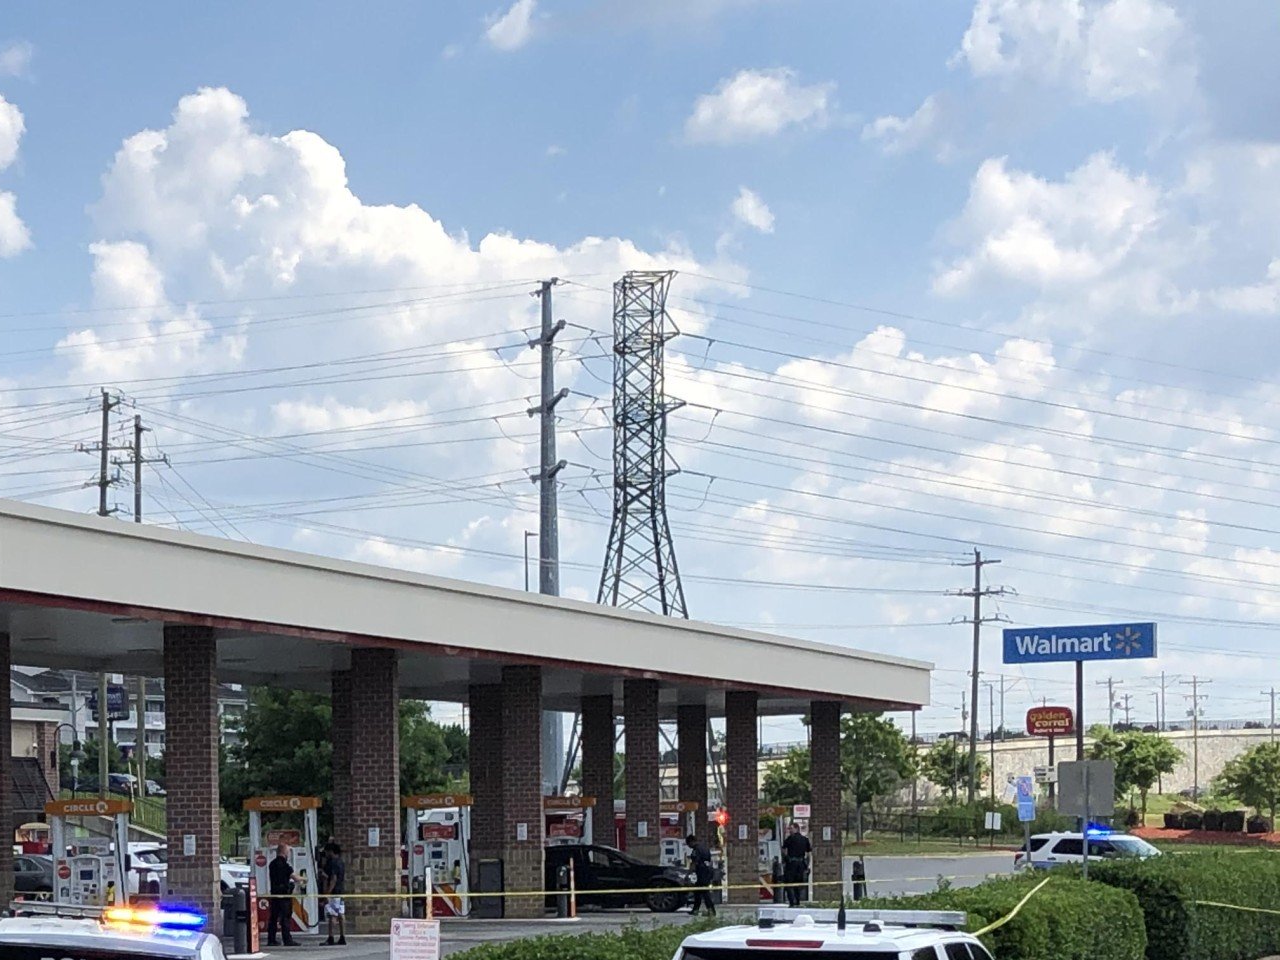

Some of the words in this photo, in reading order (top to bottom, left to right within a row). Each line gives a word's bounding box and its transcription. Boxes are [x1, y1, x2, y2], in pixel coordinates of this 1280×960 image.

[1015, 632, 1111, 655] Walmart
[1030, 711, 1066, 722] golden
[1034, 717, 1070, 728] corral
[63, 803, 95, 813] CIRCLE
[260, 800, 288, 808] CIRCLE
